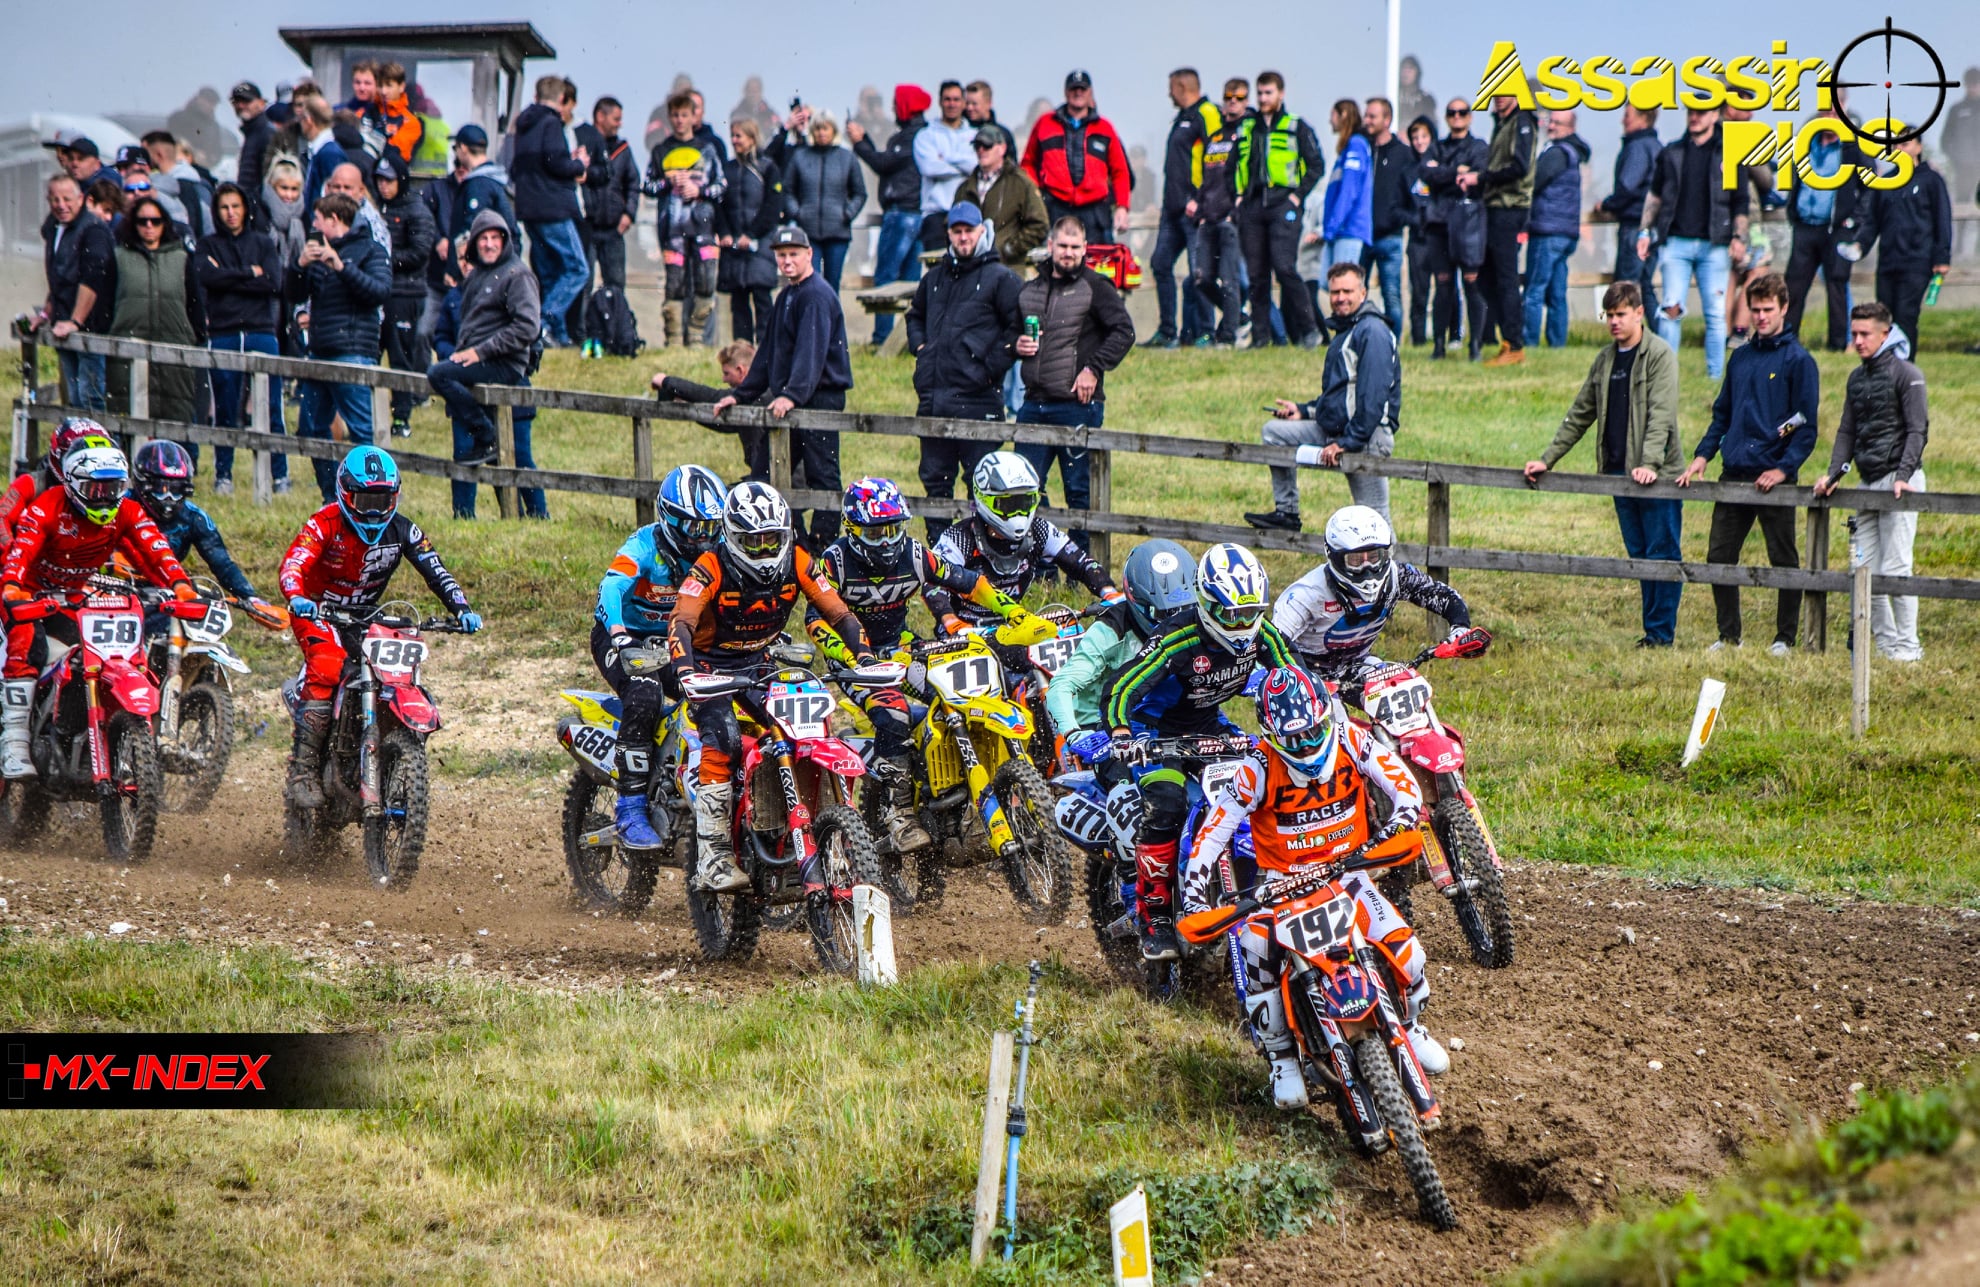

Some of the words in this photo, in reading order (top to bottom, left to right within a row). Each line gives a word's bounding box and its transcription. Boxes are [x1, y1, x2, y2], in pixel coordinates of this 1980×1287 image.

[92, 620, 138, 644] 58
[370, 640, 423, 667] 138
[946, 658, 990, 691] 11
[774, 697, 830, 726] 412
[1375, 684, 1429, 726] 430
[1286, 720, 1304, 729] BELL
[574, 726, 617, 762] 668
[1296, 802, 1342, 824] RACE
[1285, 897, 1354, 954] 192
